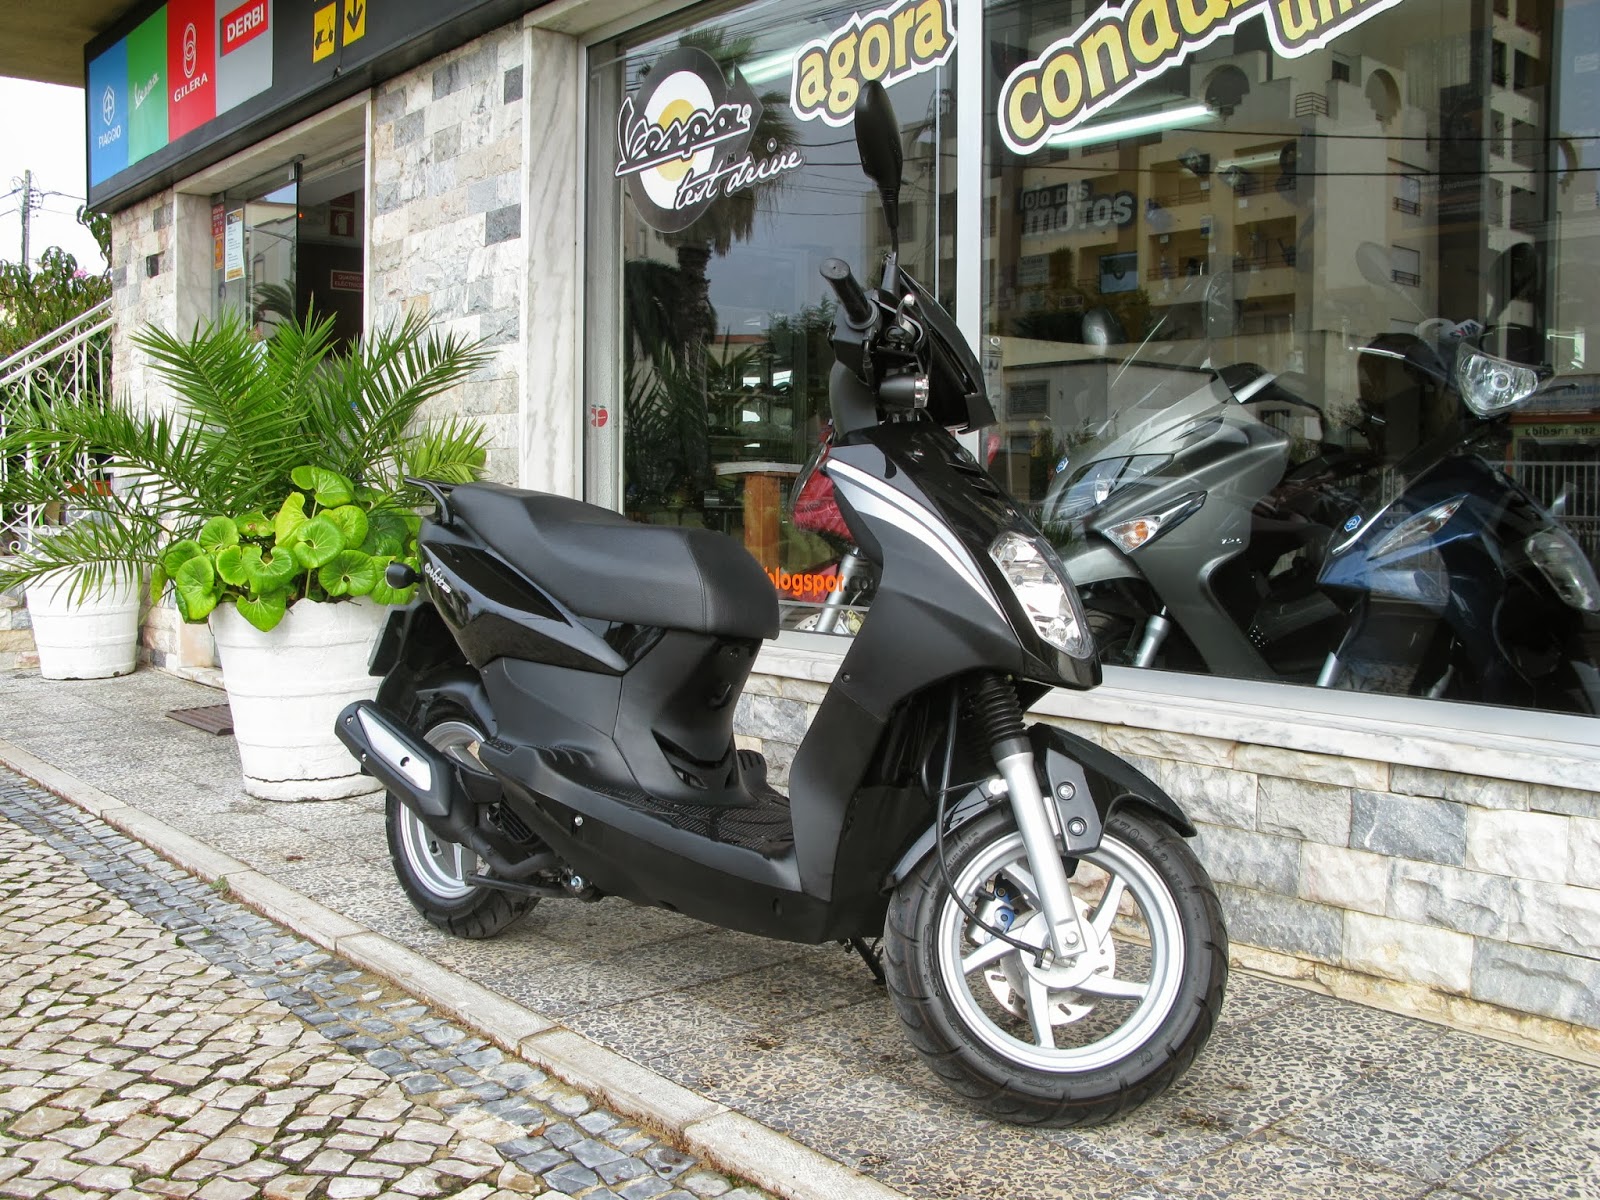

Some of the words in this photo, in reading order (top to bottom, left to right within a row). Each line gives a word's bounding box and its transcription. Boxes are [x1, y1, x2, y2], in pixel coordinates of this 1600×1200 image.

[226, 3, 265, 43] DERBI
[800, 0, 947, 114] agora
[174, 72, 208, 102] GILERA
[1009, 0, 1250, 139] condu
[98, 124, 122, 149] PIAGGIO
[615, 96, 751, 177] Vespa
[676, 159, 725, 210] test
[726, 142, 802, 194] drive
